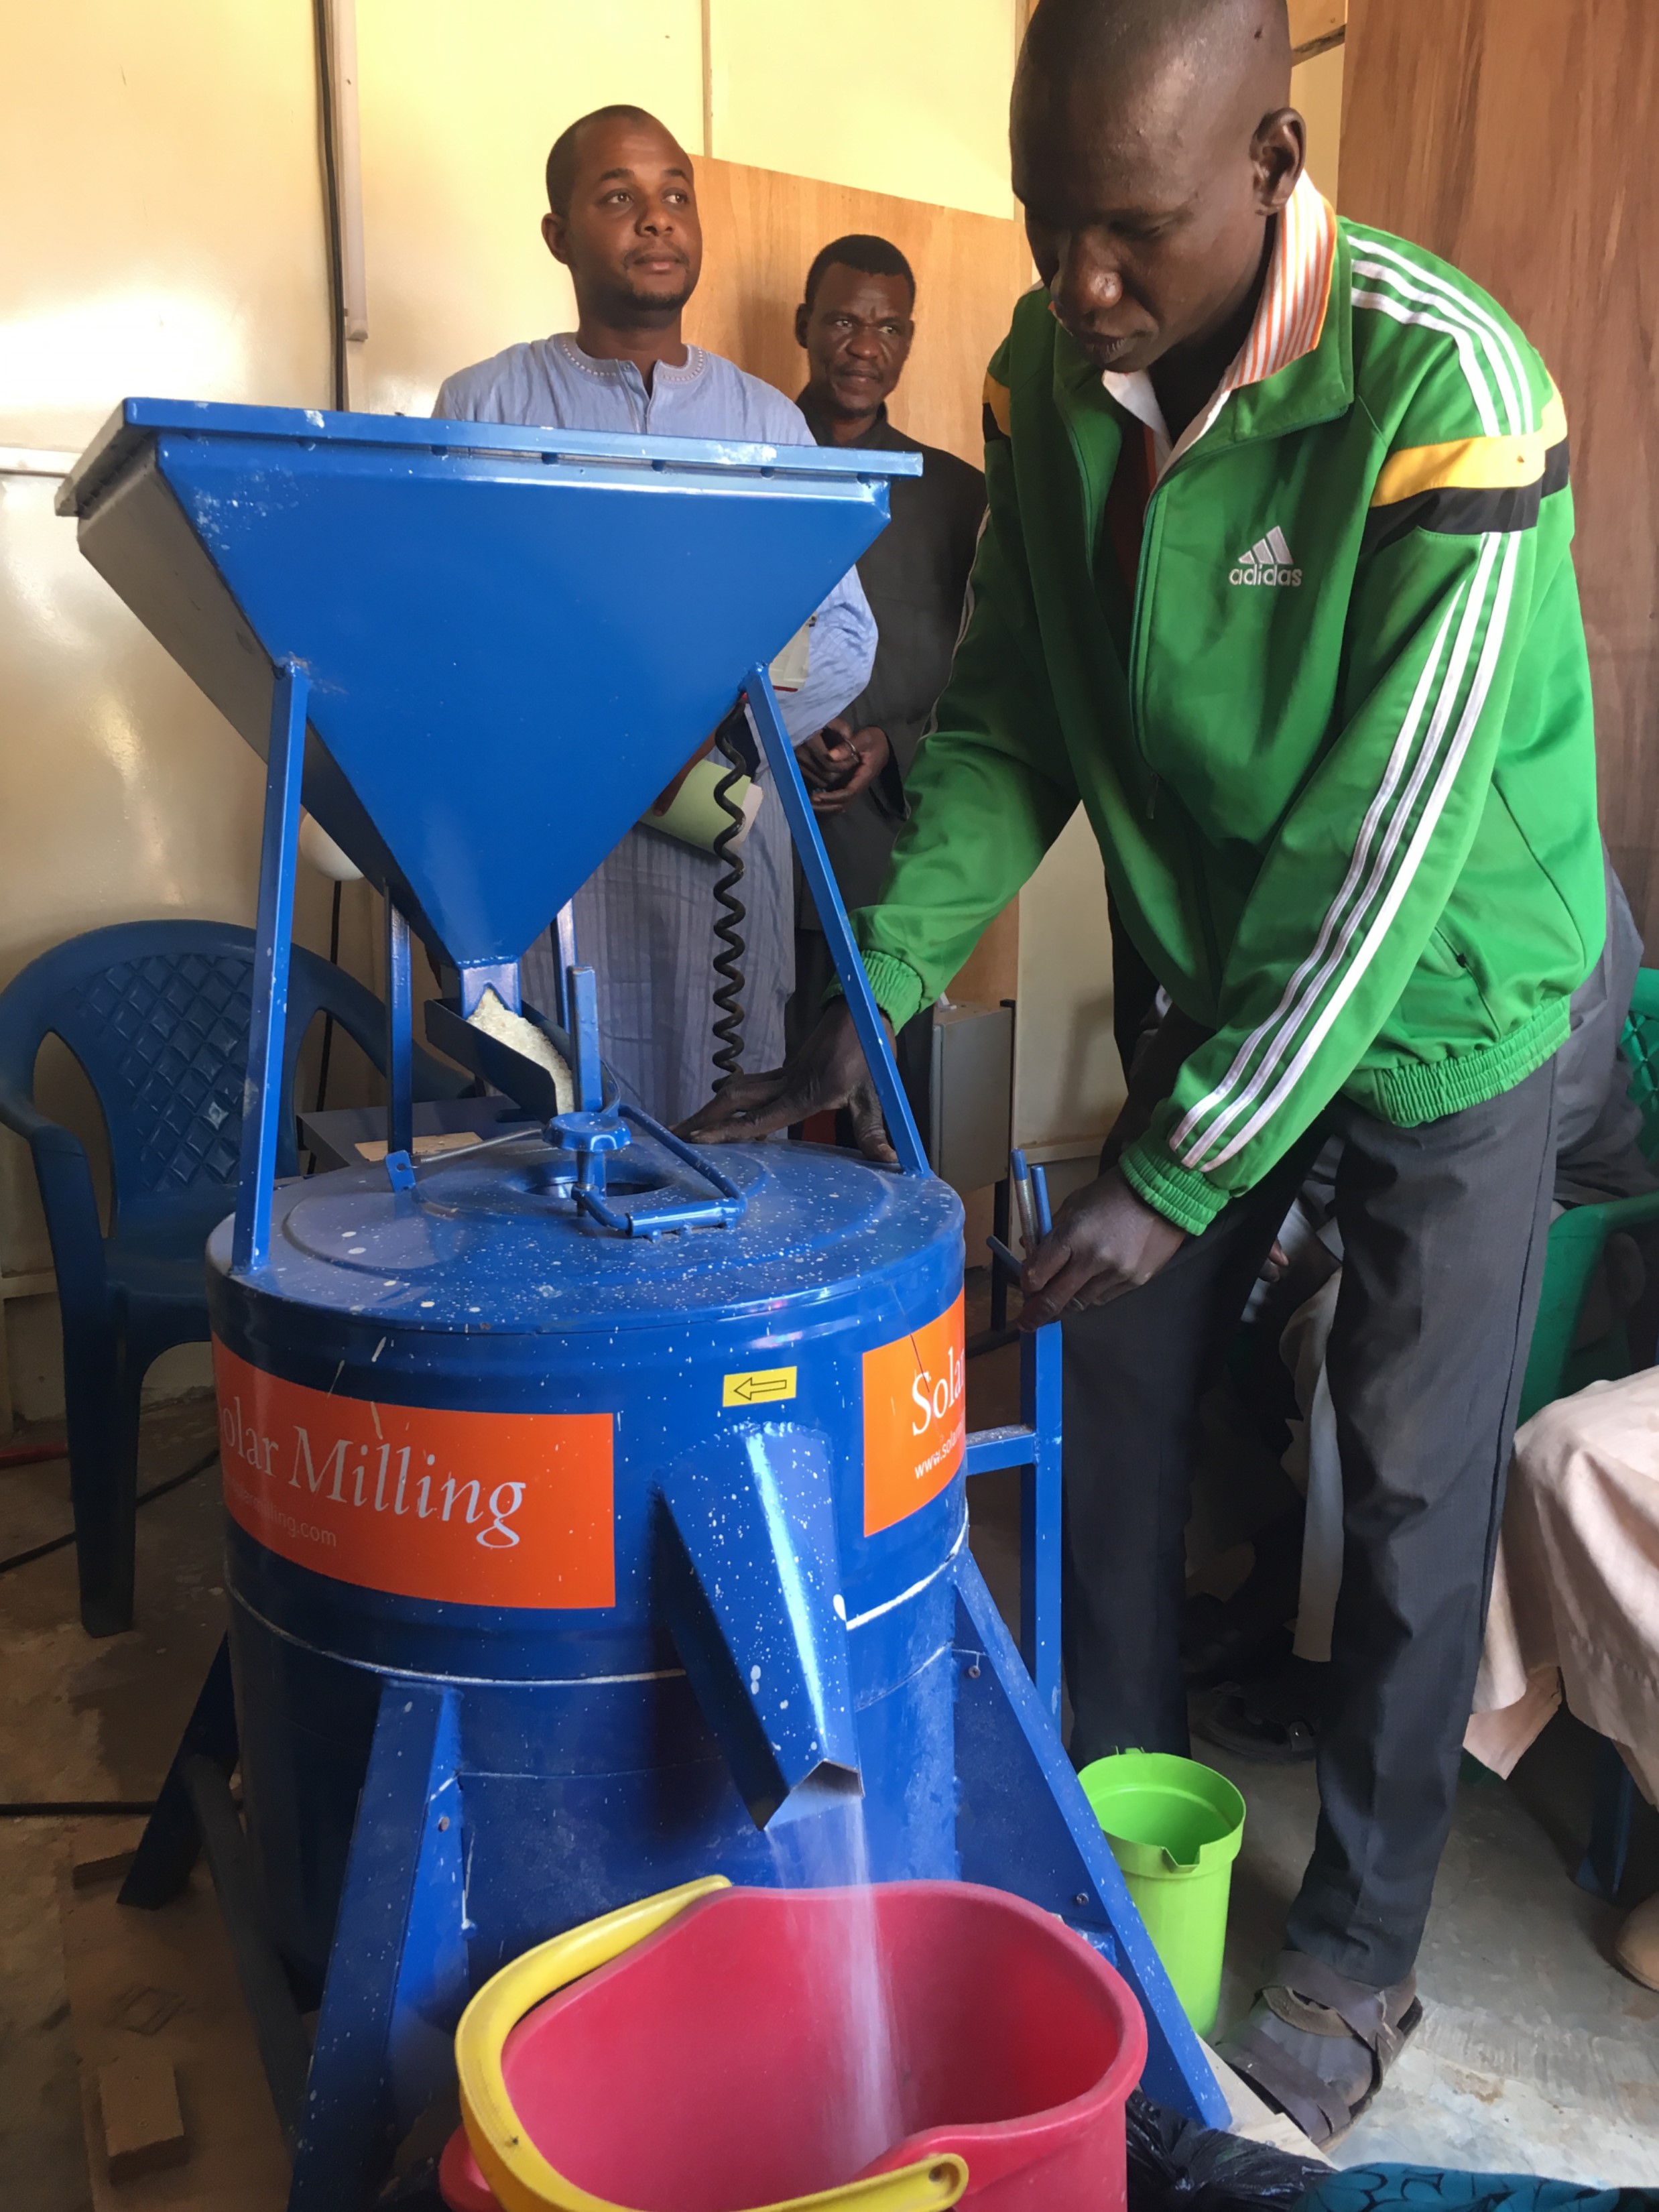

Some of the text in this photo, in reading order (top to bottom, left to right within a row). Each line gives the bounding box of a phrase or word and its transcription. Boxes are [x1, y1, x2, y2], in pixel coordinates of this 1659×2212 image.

[1229, 564, 1302, 587] adidas
[221, 1396, 526, 1548] olar Milling
